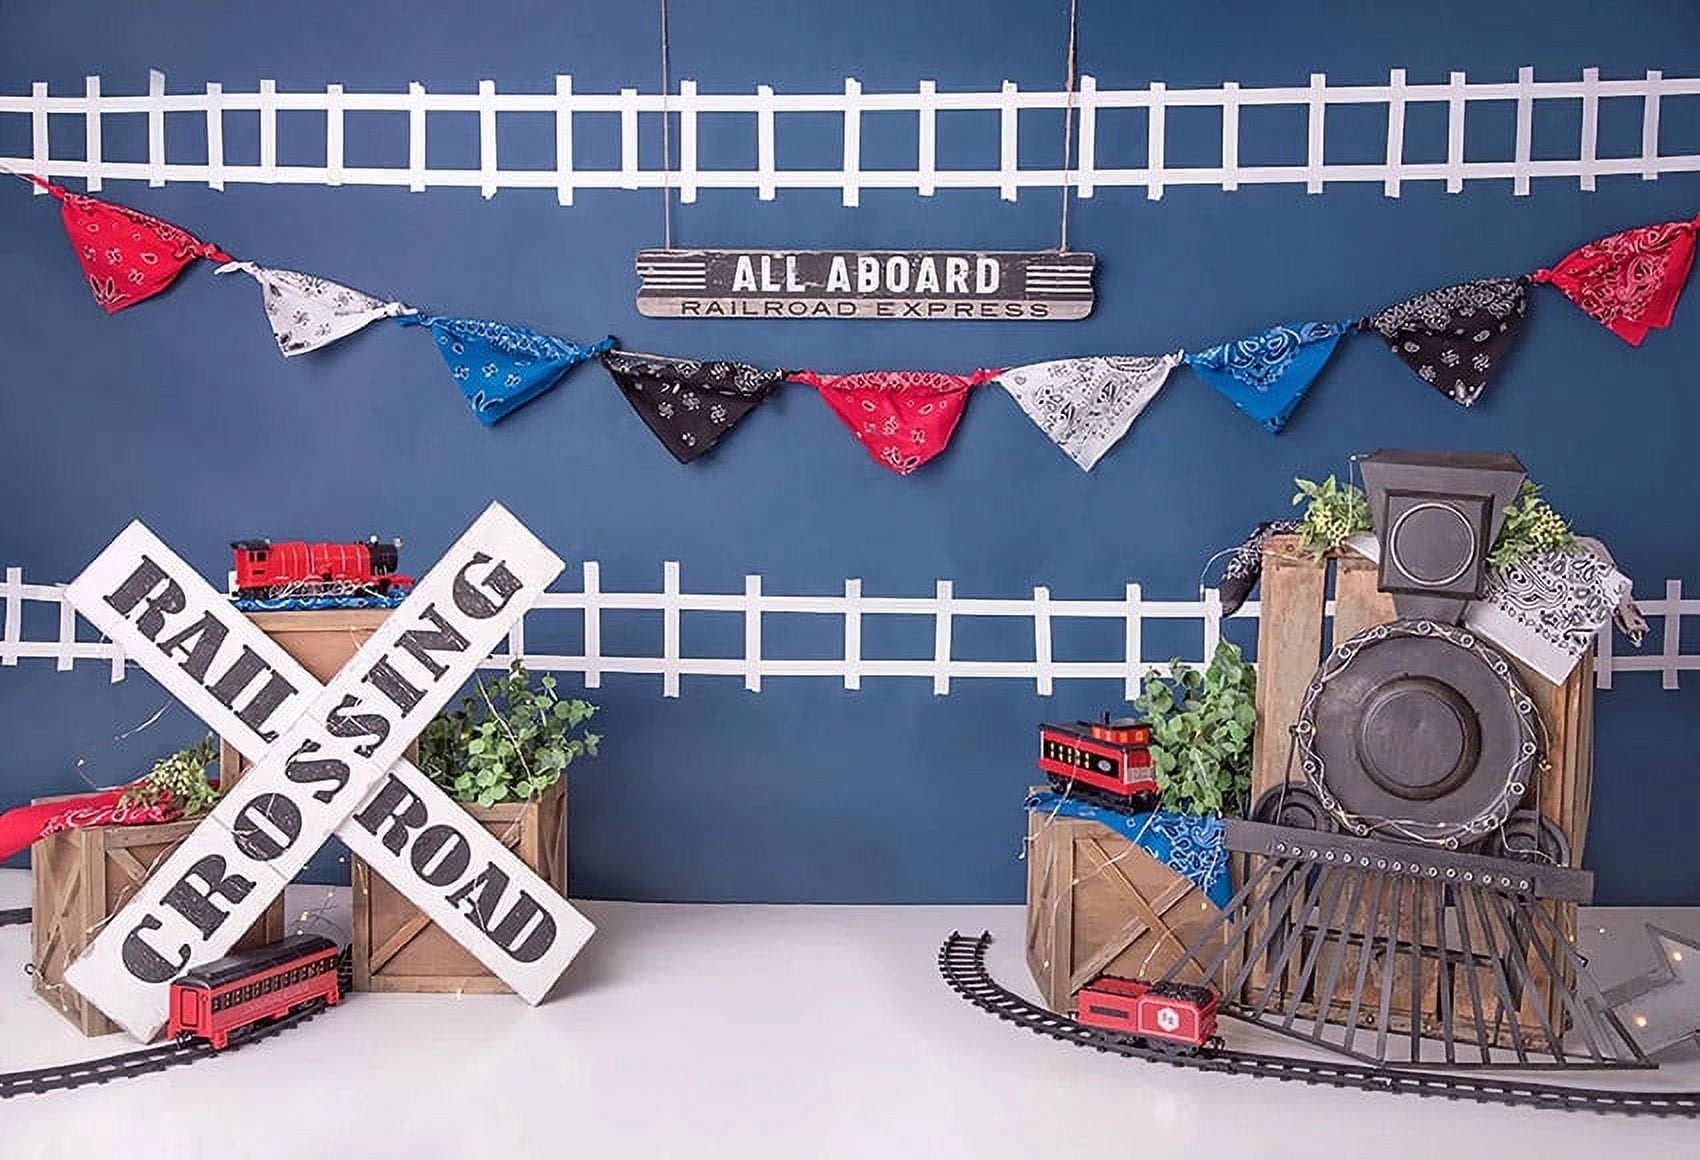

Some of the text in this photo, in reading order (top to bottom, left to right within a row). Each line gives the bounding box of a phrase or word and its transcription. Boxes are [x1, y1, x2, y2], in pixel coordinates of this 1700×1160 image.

[681, 301, 1050, 318] RAILROAD EXPRESS
[731, 255, 1000, 294] ALL ABOARD
[102, 555, 557, 963] RAIL ROAD
[122, 551, 522, 984] CROSSING
